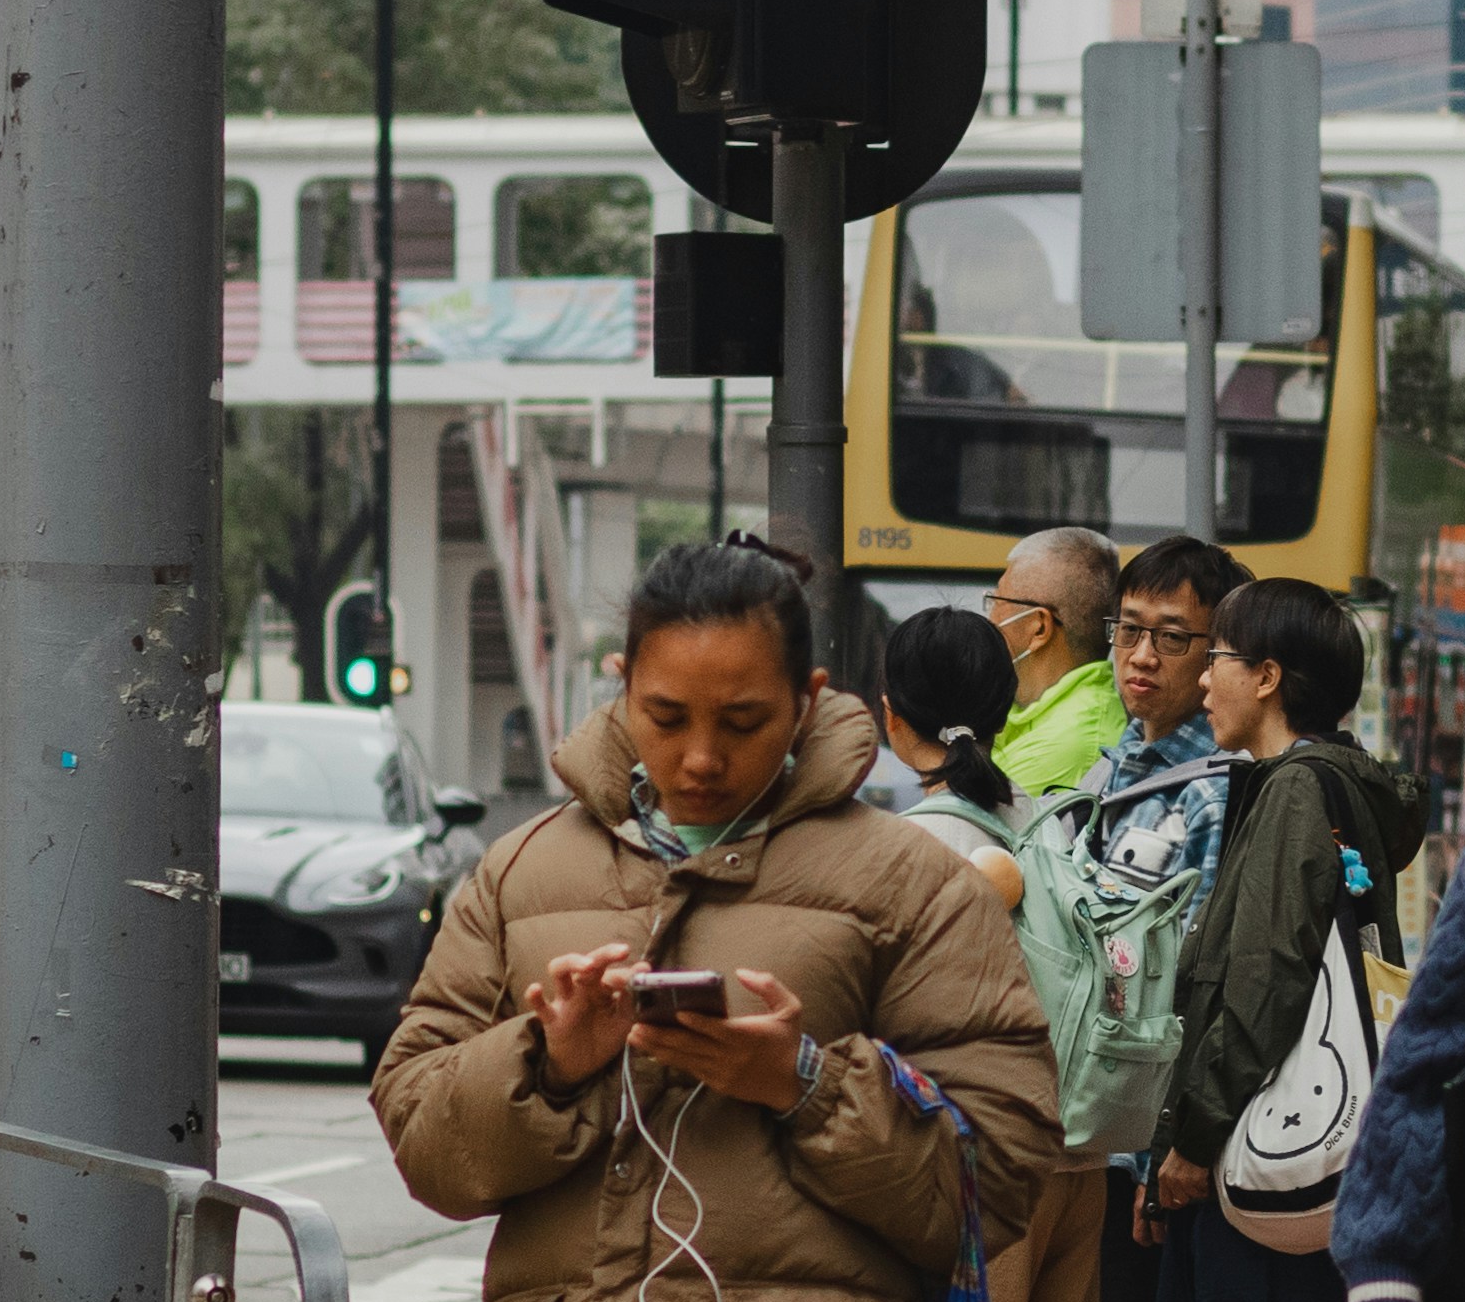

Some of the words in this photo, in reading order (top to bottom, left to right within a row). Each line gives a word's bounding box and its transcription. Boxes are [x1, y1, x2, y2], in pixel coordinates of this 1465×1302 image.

[858, 526, 912, 550] 8195
[1324, 1126, 1345, 1152] Dick
[1342, 1095, 1358, 1130] Bruna
